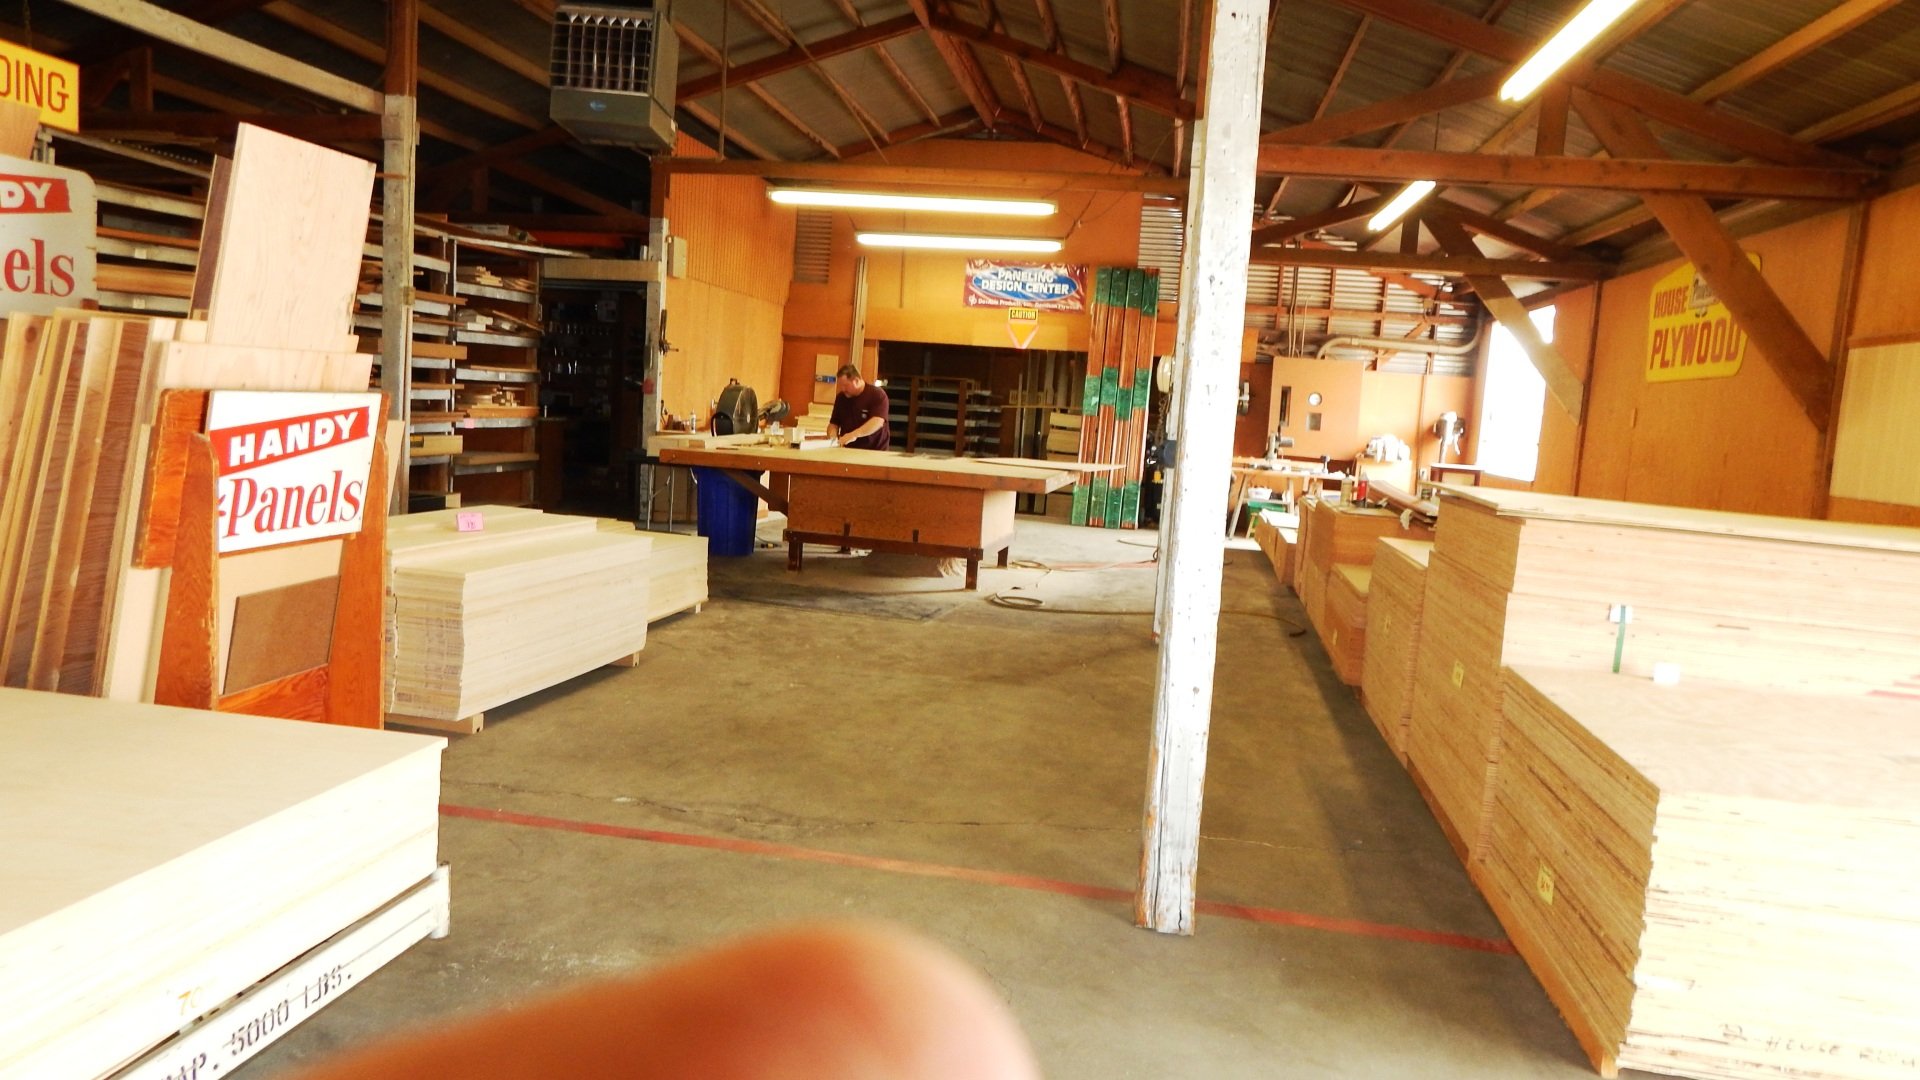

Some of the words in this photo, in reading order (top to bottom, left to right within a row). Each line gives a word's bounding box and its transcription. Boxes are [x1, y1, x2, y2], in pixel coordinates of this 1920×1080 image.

[981, 279, 1023, 292] DESIGN
[1025, 283, 1070, 295] CENTER
[997, 267, 1054, 283] PANELING
[1011, 309, 1036, 319] CAUTION
[1654, 286, 1689, 319] HOUSE
[1649, 319, 1740, 370] PLYWOOD
[229, 411, 358, 467] HANDY
[222, 470, 363, 538] Panels
[230, 998, 290, 1056] 5000
